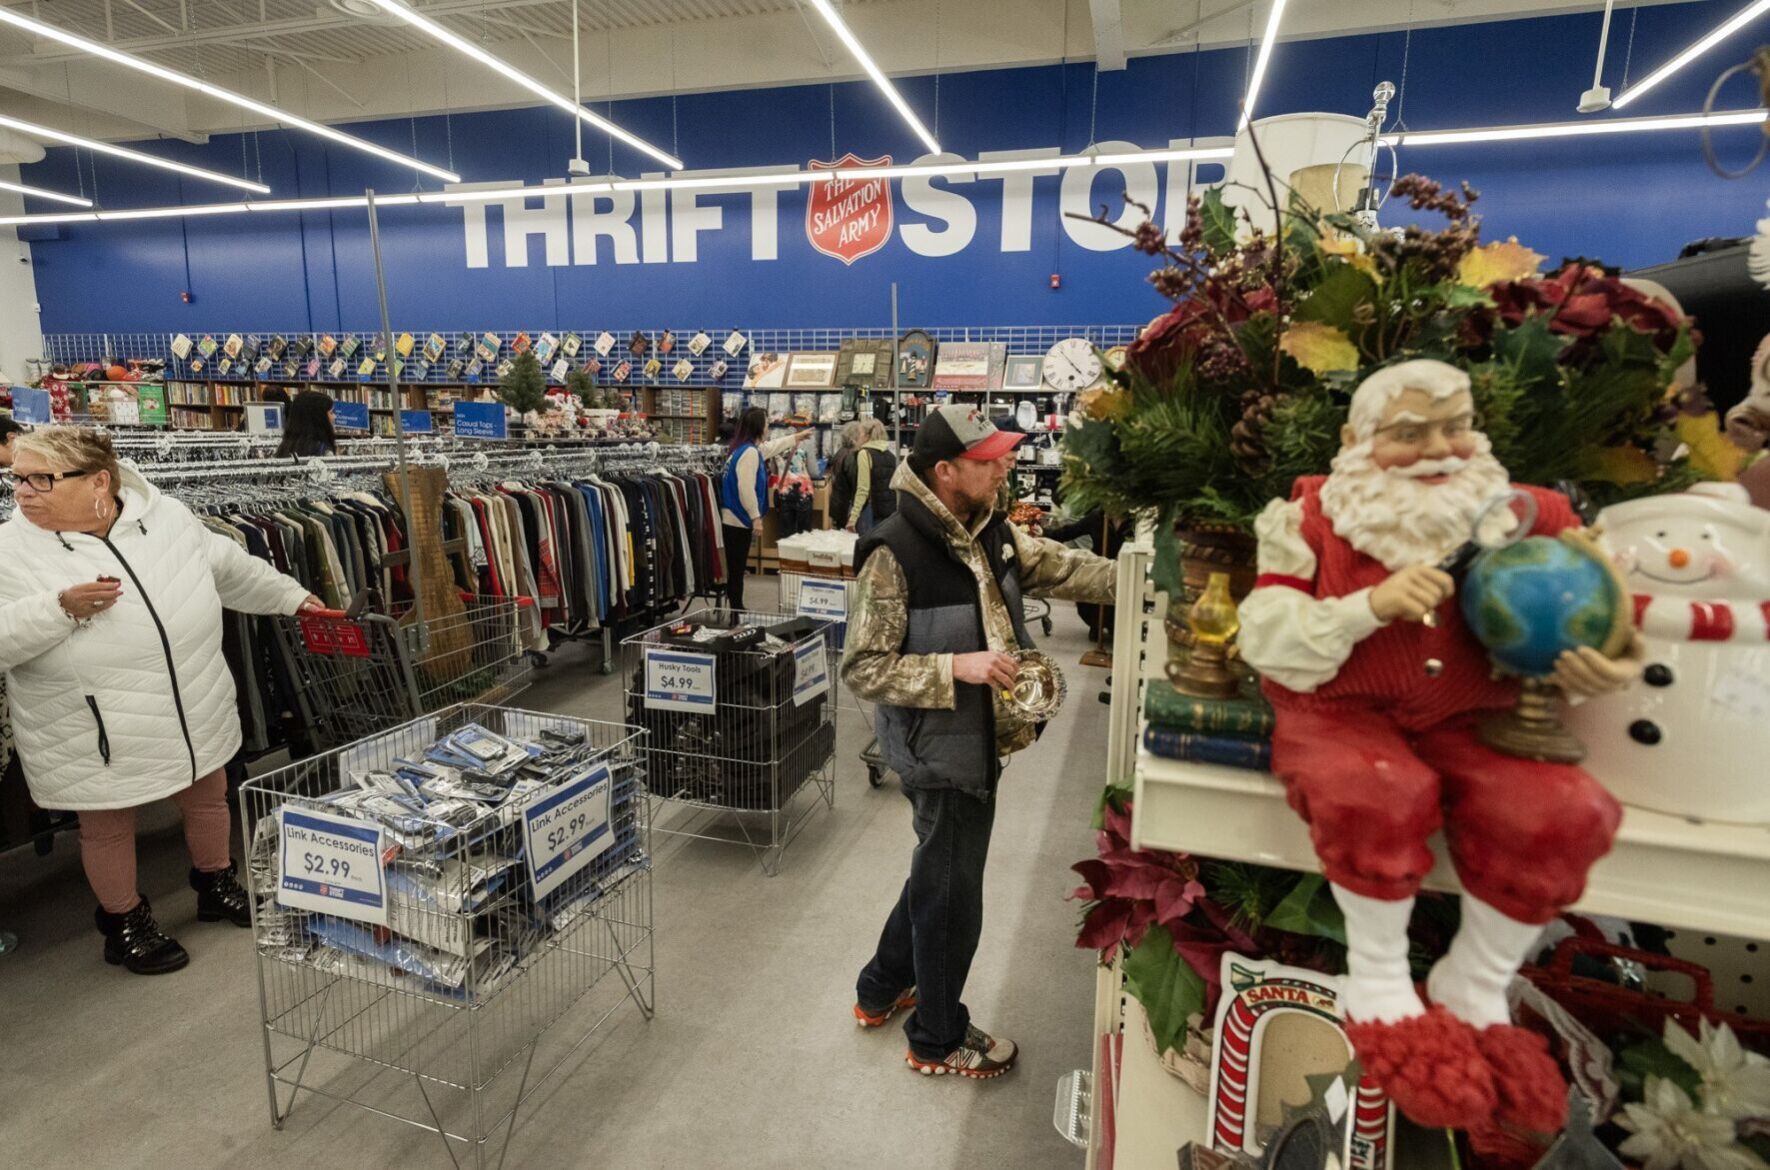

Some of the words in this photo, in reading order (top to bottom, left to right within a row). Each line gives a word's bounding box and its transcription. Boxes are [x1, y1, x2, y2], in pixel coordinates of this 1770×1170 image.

[445, 164, 800, 269] THRIFT
[900, 136, 1236, 258] STOR
[824, 177, 856, 202] THE
[814, 177, 882, 235] SALVATION
[838, 202, 881, 249] ARMY
[456, 419, 479, 428] Casual
[479, 420, 494, 429] Tops
[456, 427, 473, 436] Long
[473, 428, 494, 436] Sleeve
[658, 663, 681, 673] Husky
[682, 664, 701, 674] Tools
[660, 675, 693, 689] $4.99
[531, 815, 552, 833] Link
[554, 782, 608, 820] Accessories
[287, 827, 308, 841] Link
[310, 833, 375, 858] Accessories
[547, 813, 586, 852] $2.99
[304, 851, 351, 878] $2.99
[1246, 986, 1311, 1005] SANTA
